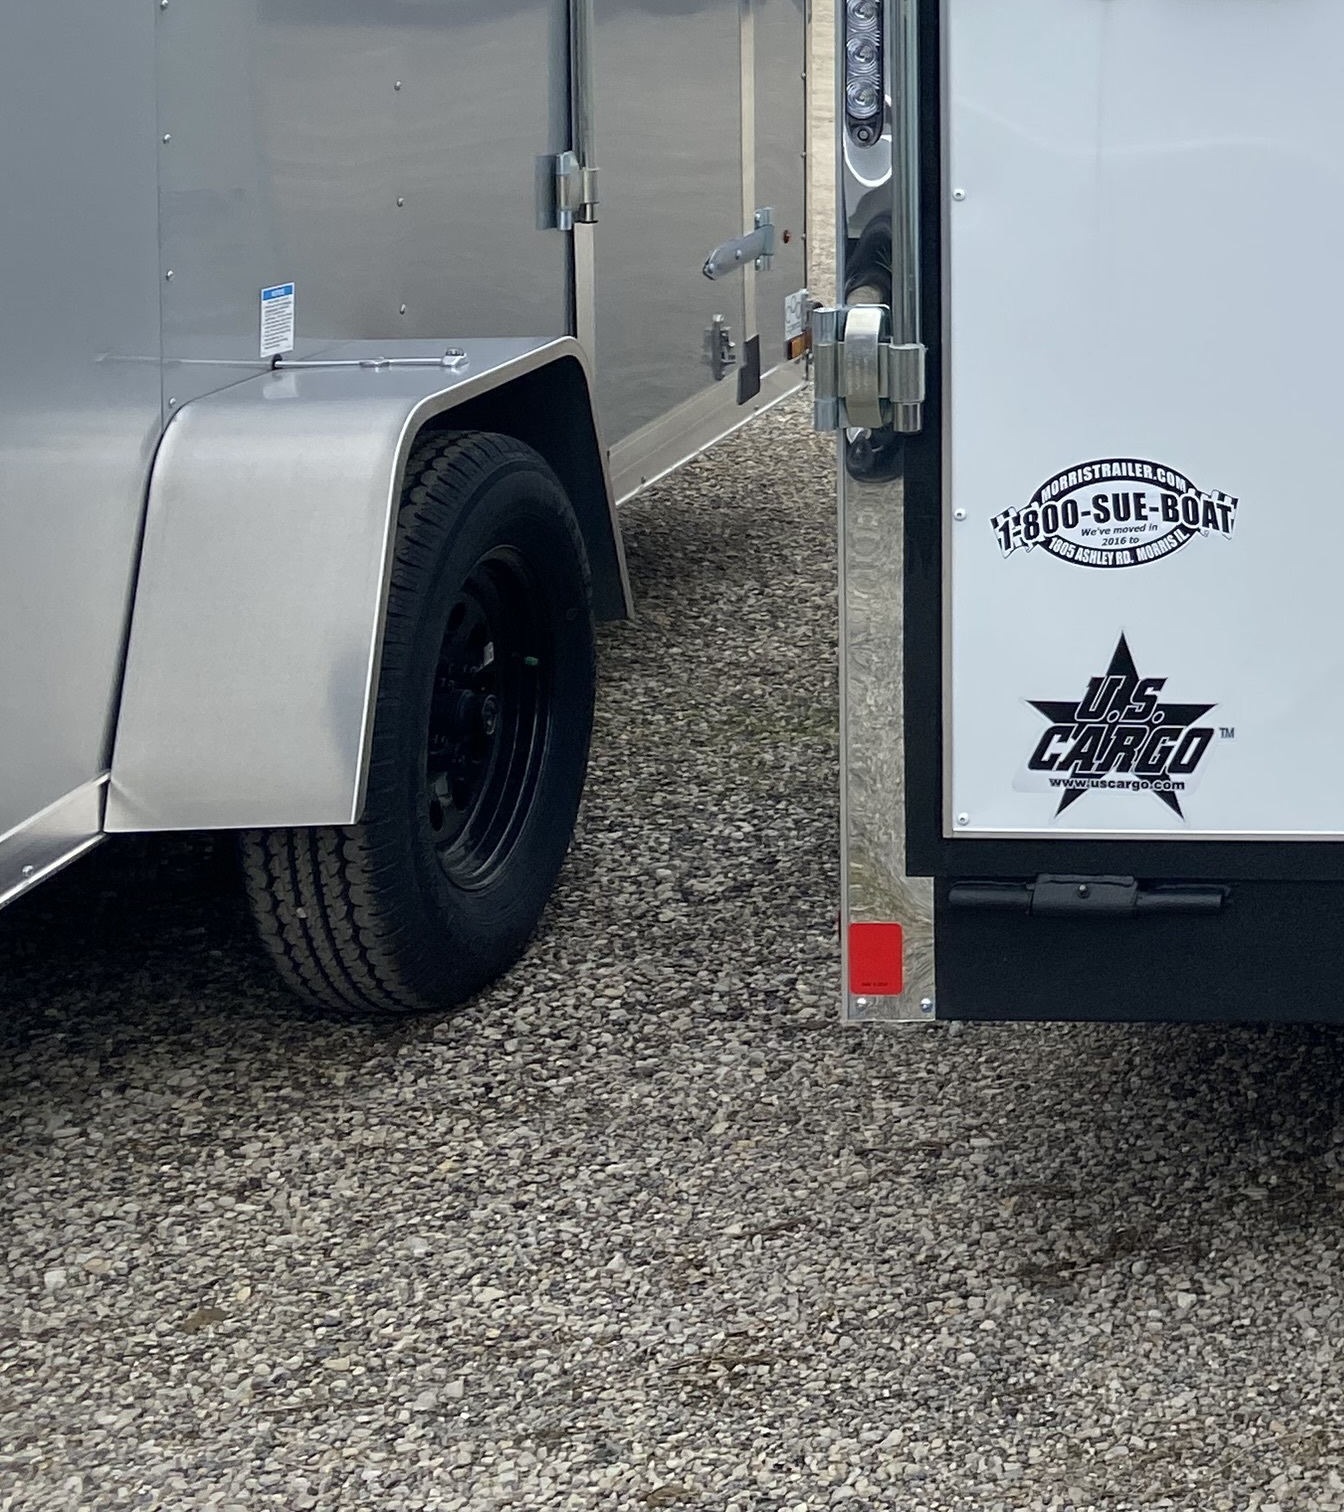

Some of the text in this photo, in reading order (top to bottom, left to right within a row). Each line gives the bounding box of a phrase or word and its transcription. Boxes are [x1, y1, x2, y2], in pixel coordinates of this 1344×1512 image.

[1041, 462, 1187, 504] MORRISTRAILER.COM
[999, 492, 1234, 551] 1-800-SUE-BOAT
[1081, 522, 1158, 537] We've moved in
[1049, 537, 1075, 559] 1805
[1074, 547, 1114, 566] ASHLEY
[1116, 549, 1135, 565] RD.
[1136, 534, 1178, 563] MORRIS
[1102, 536, 1140, 546] 2016 to
[1074, 675, 1168, 724] U.S.
[1027, 724, 1215, 775] CARGO
[1049, 778, 1185, 791] www.uscargo.com
